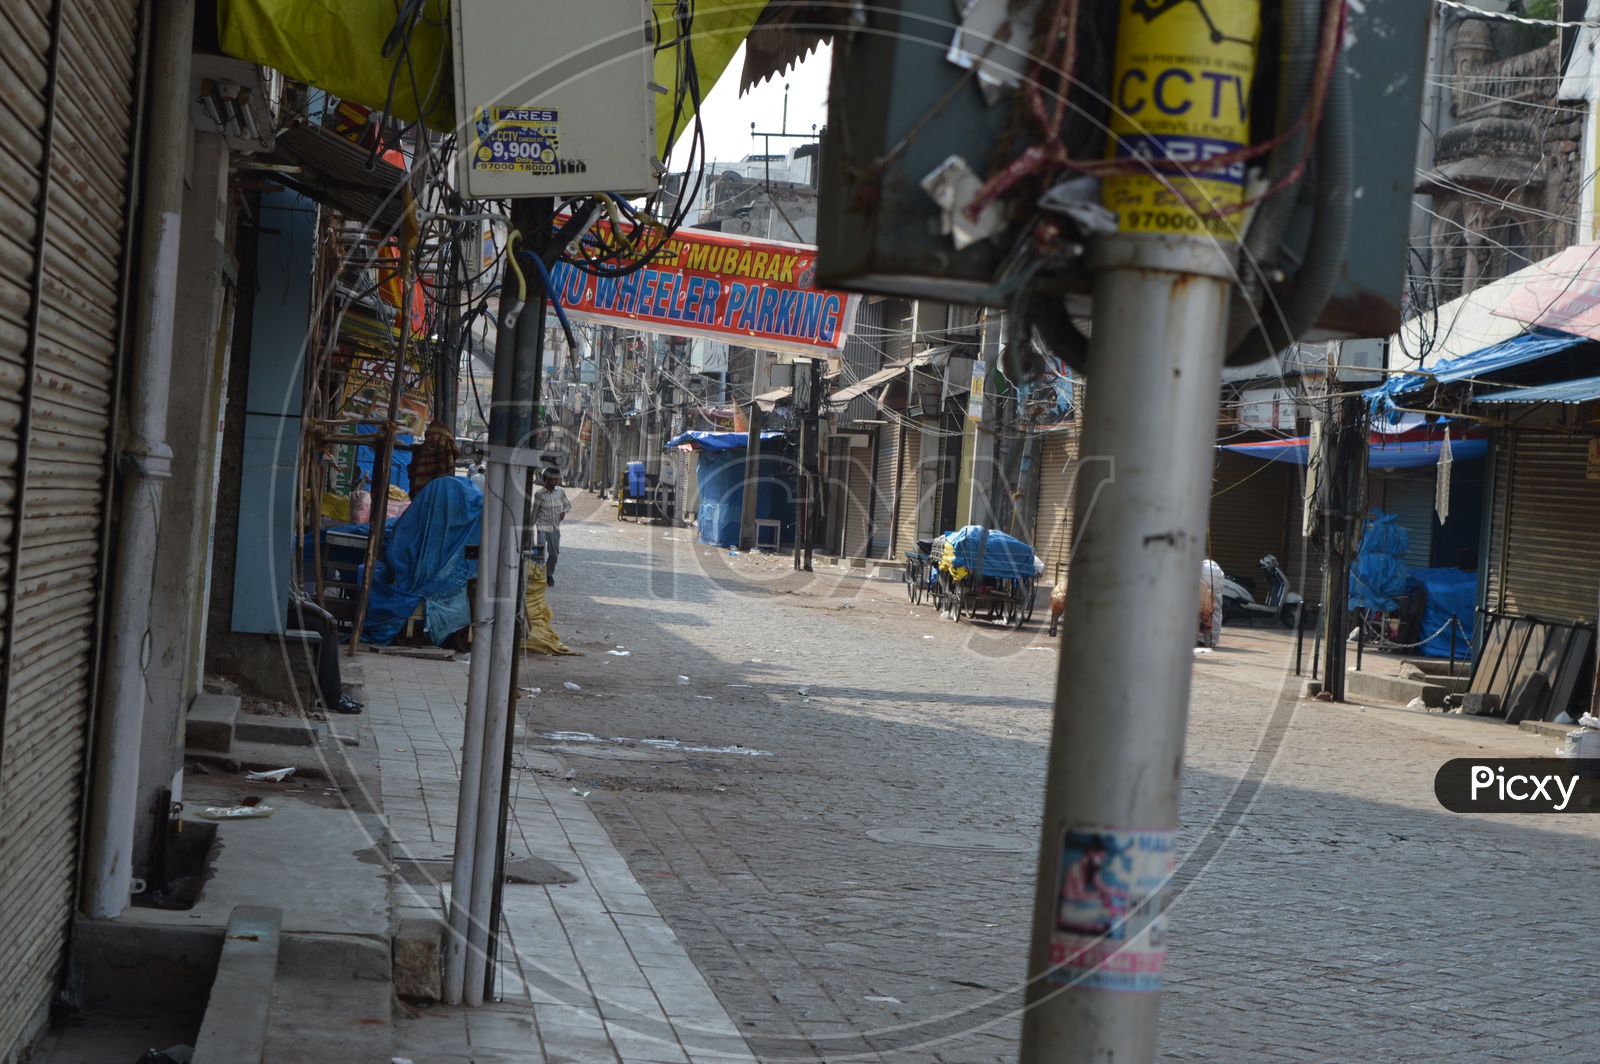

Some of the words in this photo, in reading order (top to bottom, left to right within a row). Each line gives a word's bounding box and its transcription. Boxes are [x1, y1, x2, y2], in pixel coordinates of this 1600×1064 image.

[505, 111, 552, 121] ARES
[493, 141, 541, 160] 9,900
[481, 163, 515, 171] 97000
[520, 164, 553, 172] 18000
[686, 242, 799, 283] MUBARAK
[597, 262, 725, 325] WHEELER
[724, 282, 841, 343] PARKING
